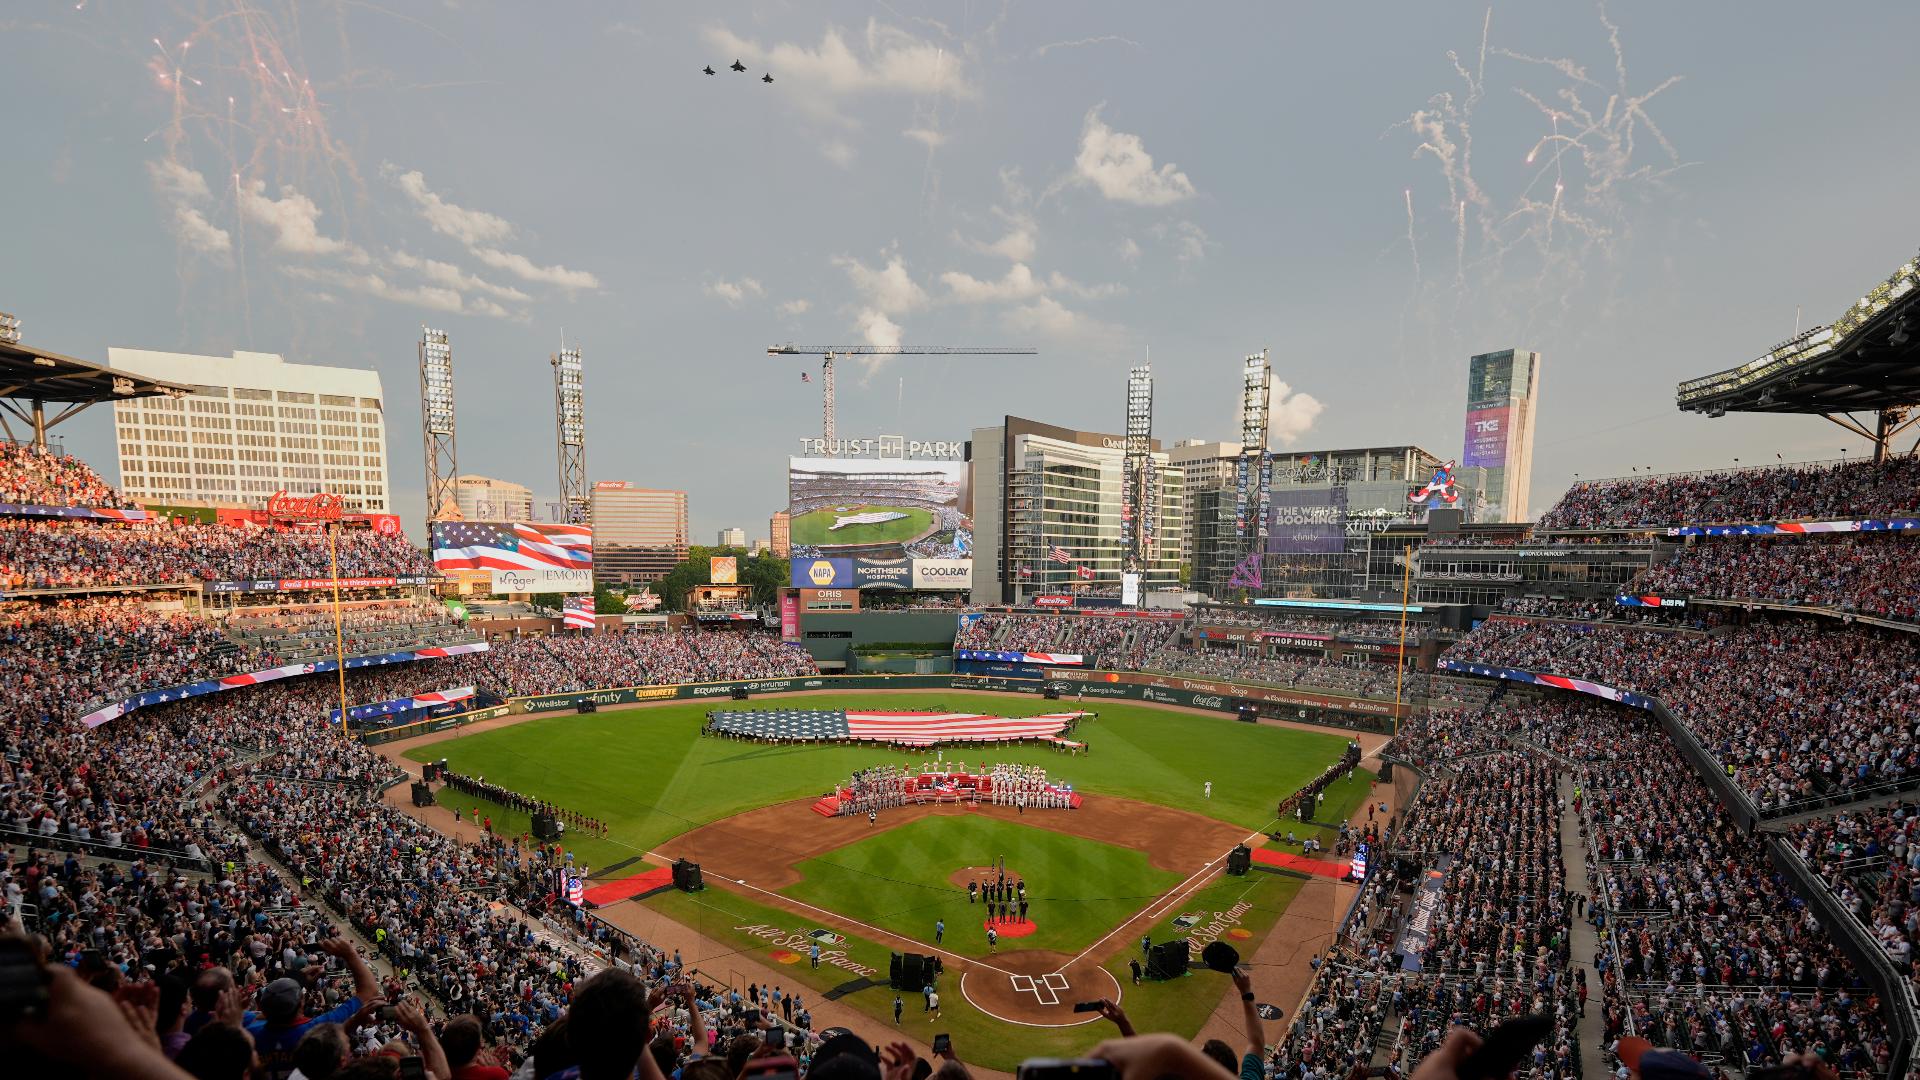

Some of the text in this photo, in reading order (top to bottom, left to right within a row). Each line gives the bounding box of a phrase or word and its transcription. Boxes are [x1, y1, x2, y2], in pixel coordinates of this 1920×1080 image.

[1475, 420, 1499, 432] TKE
[800, 438, 962, 457] TRUIST PARK
[1275, 465, 1344, 481] COMCAST
[477, 500, 587, 524] DELTA
[1277, 506, 1299, 516] THE
[1276, 515, 1338, 525] BOOMING
[1345, 519, 1391, 534] xfinity
[1292, 532, 1319, 542] xfinity
[546, 570, 591, 582] EMORY
[813, 567, 832, 579] NAPA
[857, 567, 909, 575] NORTHSIDE
[921, 567, 969, 576] COOLRAY
[311, 580, 325, 588] Fan
[350, 578, 370, 587] thirsty
[500, 571, 536, 591] Kroger
[818, 590, 842, 598] ORIS
[1038, 597, 1070, 605] RaceTrac
[1674, 599, 1685, 607] PM
[1226, 633, 1246, 641] LIGHT
[1270, 636, 1292, 645] CHOP
[1294, 638, 1324, 648] HOUSE
[760, 681, 791, 689] HYUNDAI
[1191, 683, 1217, 692] FANDUEL
[635, 688, 678, 698] QUIKRETE
[693, 686, 732, 695] EQUIFAX
[1088, 686, 1126, 695] Georgia Power
[536, 699, 570, 708] Wellstar
[1192, 694, 1224, 708] Coca-Cola
